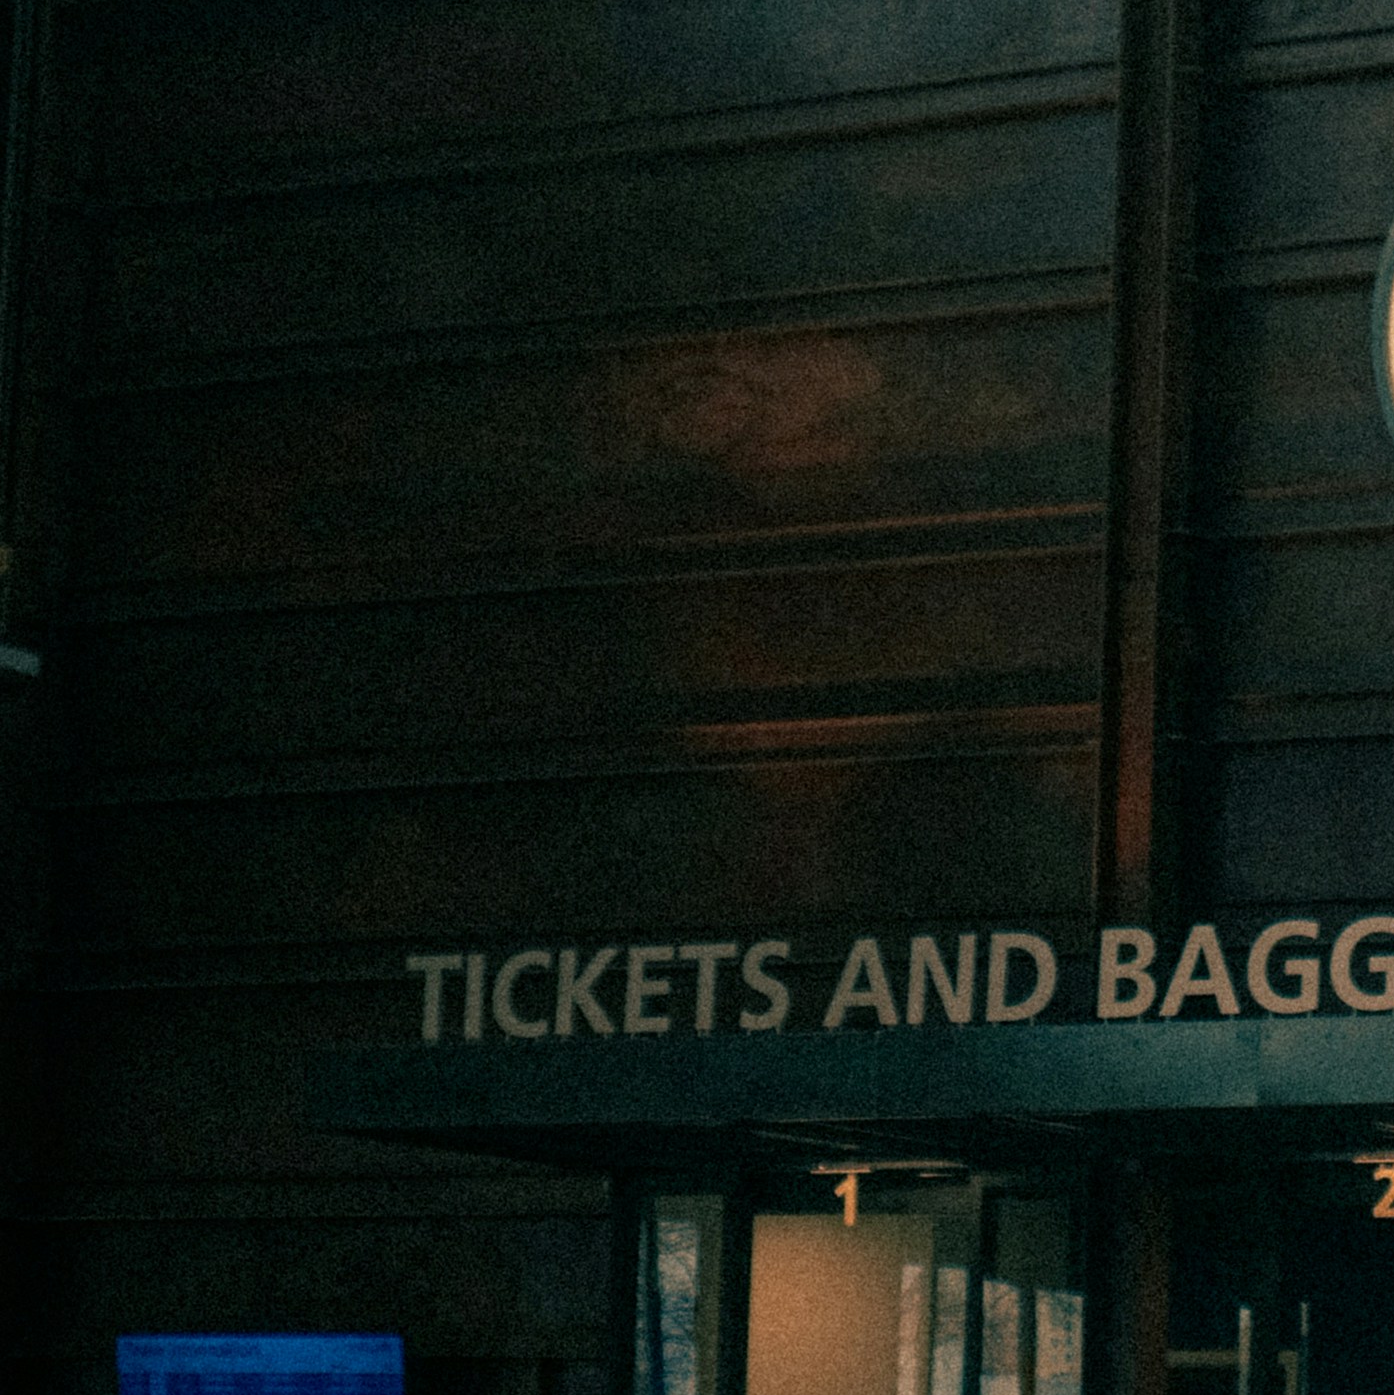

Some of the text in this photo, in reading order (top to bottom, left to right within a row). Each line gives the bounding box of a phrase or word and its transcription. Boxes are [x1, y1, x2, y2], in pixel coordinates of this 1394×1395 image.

[406, 941, 792, 1042] TICKETS
[822, 932, 1058, 1028] AND
[833, 1172, 857, 1226] 1
